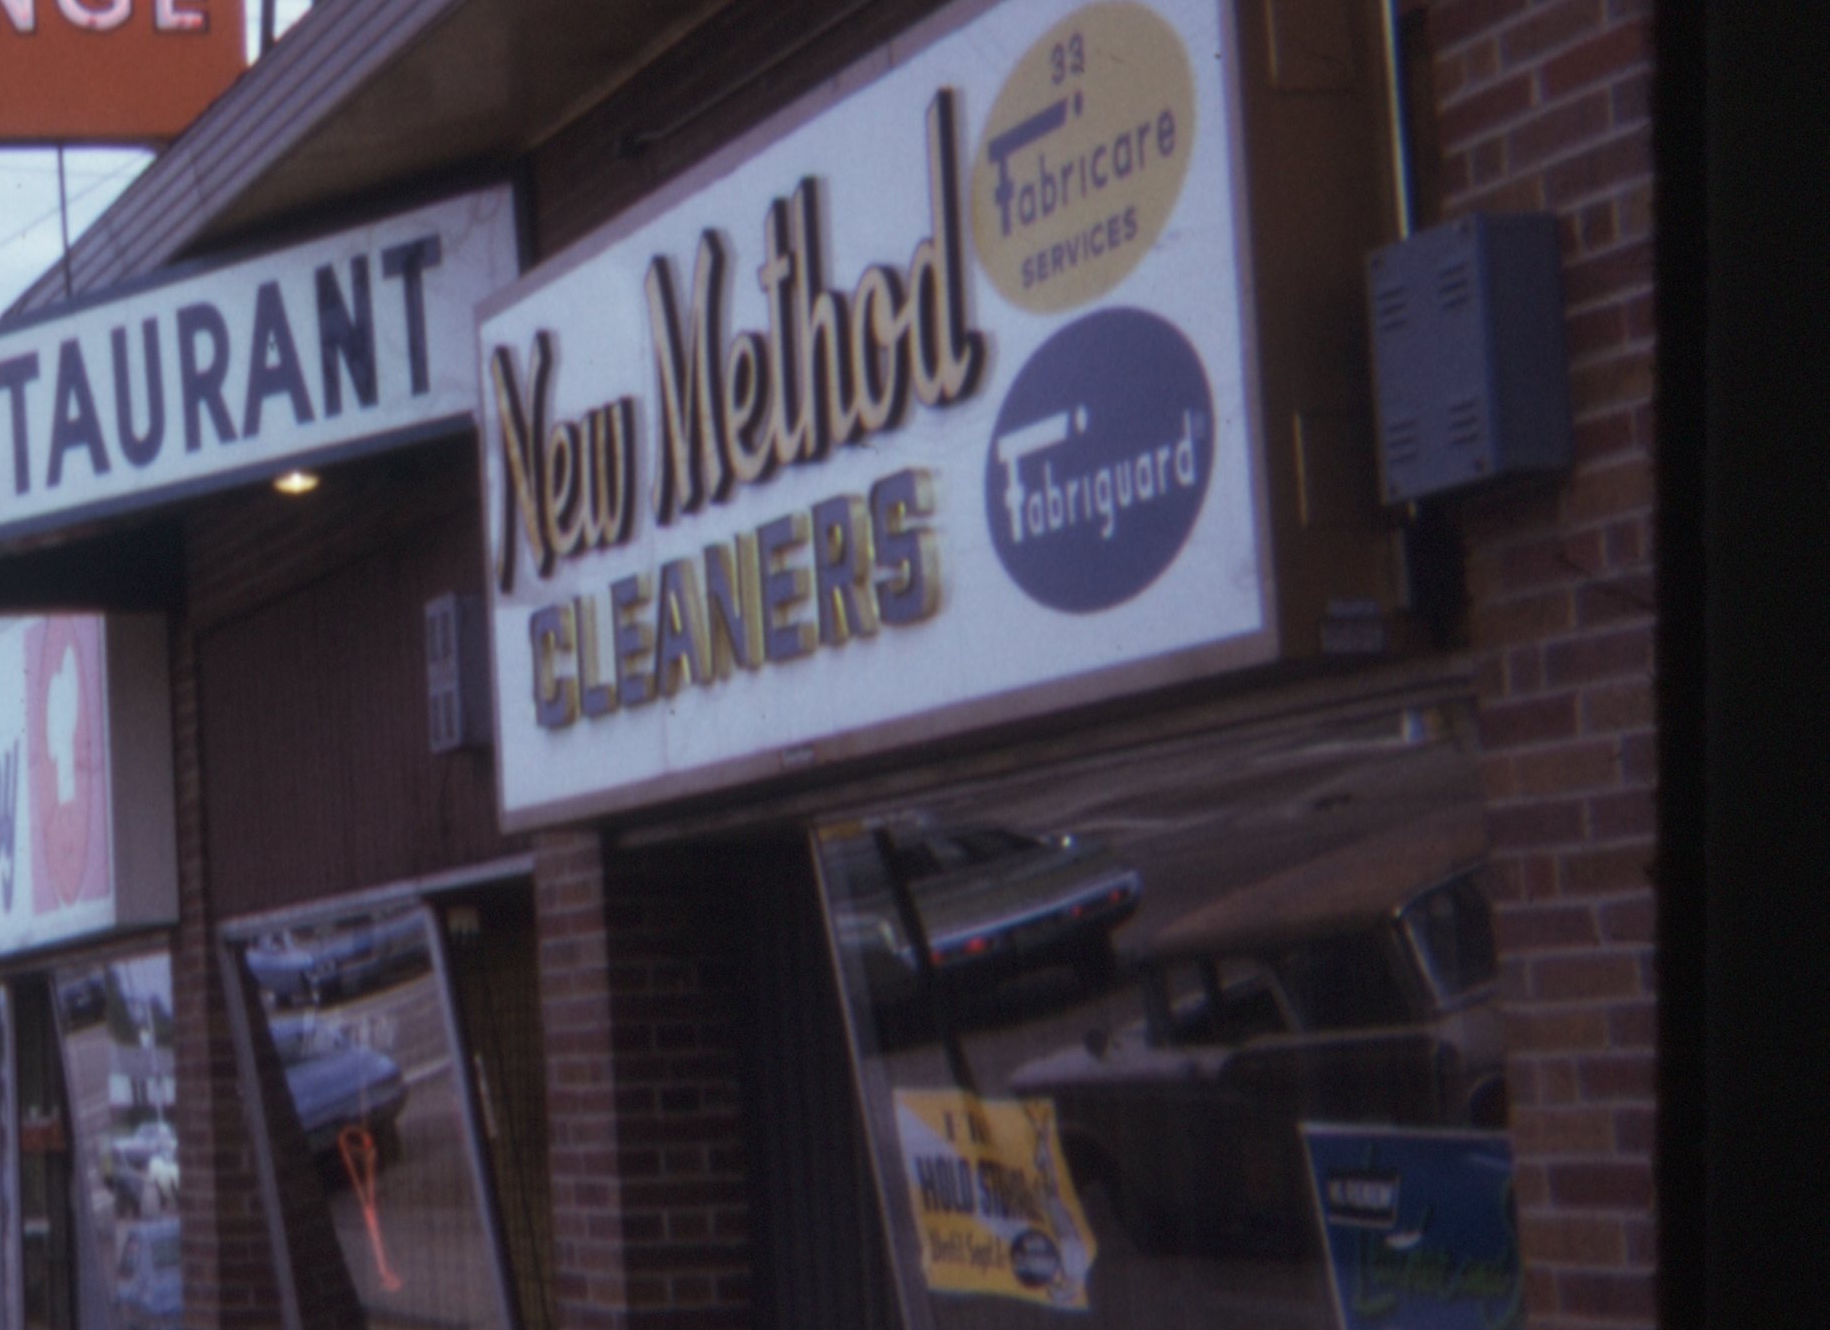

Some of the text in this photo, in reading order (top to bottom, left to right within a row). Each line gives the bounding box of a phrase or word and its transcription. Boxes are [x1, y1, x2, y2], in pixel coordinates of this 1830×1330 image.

[987, 91, 1176, 238] Fabricare
[1022, 206, 1138, 290] SERVICES
[490, 84, 988, 595] New Method
[997, 404, 1197, 544] Fabriguard
[529, 467, 942, 731] CLEANERS
